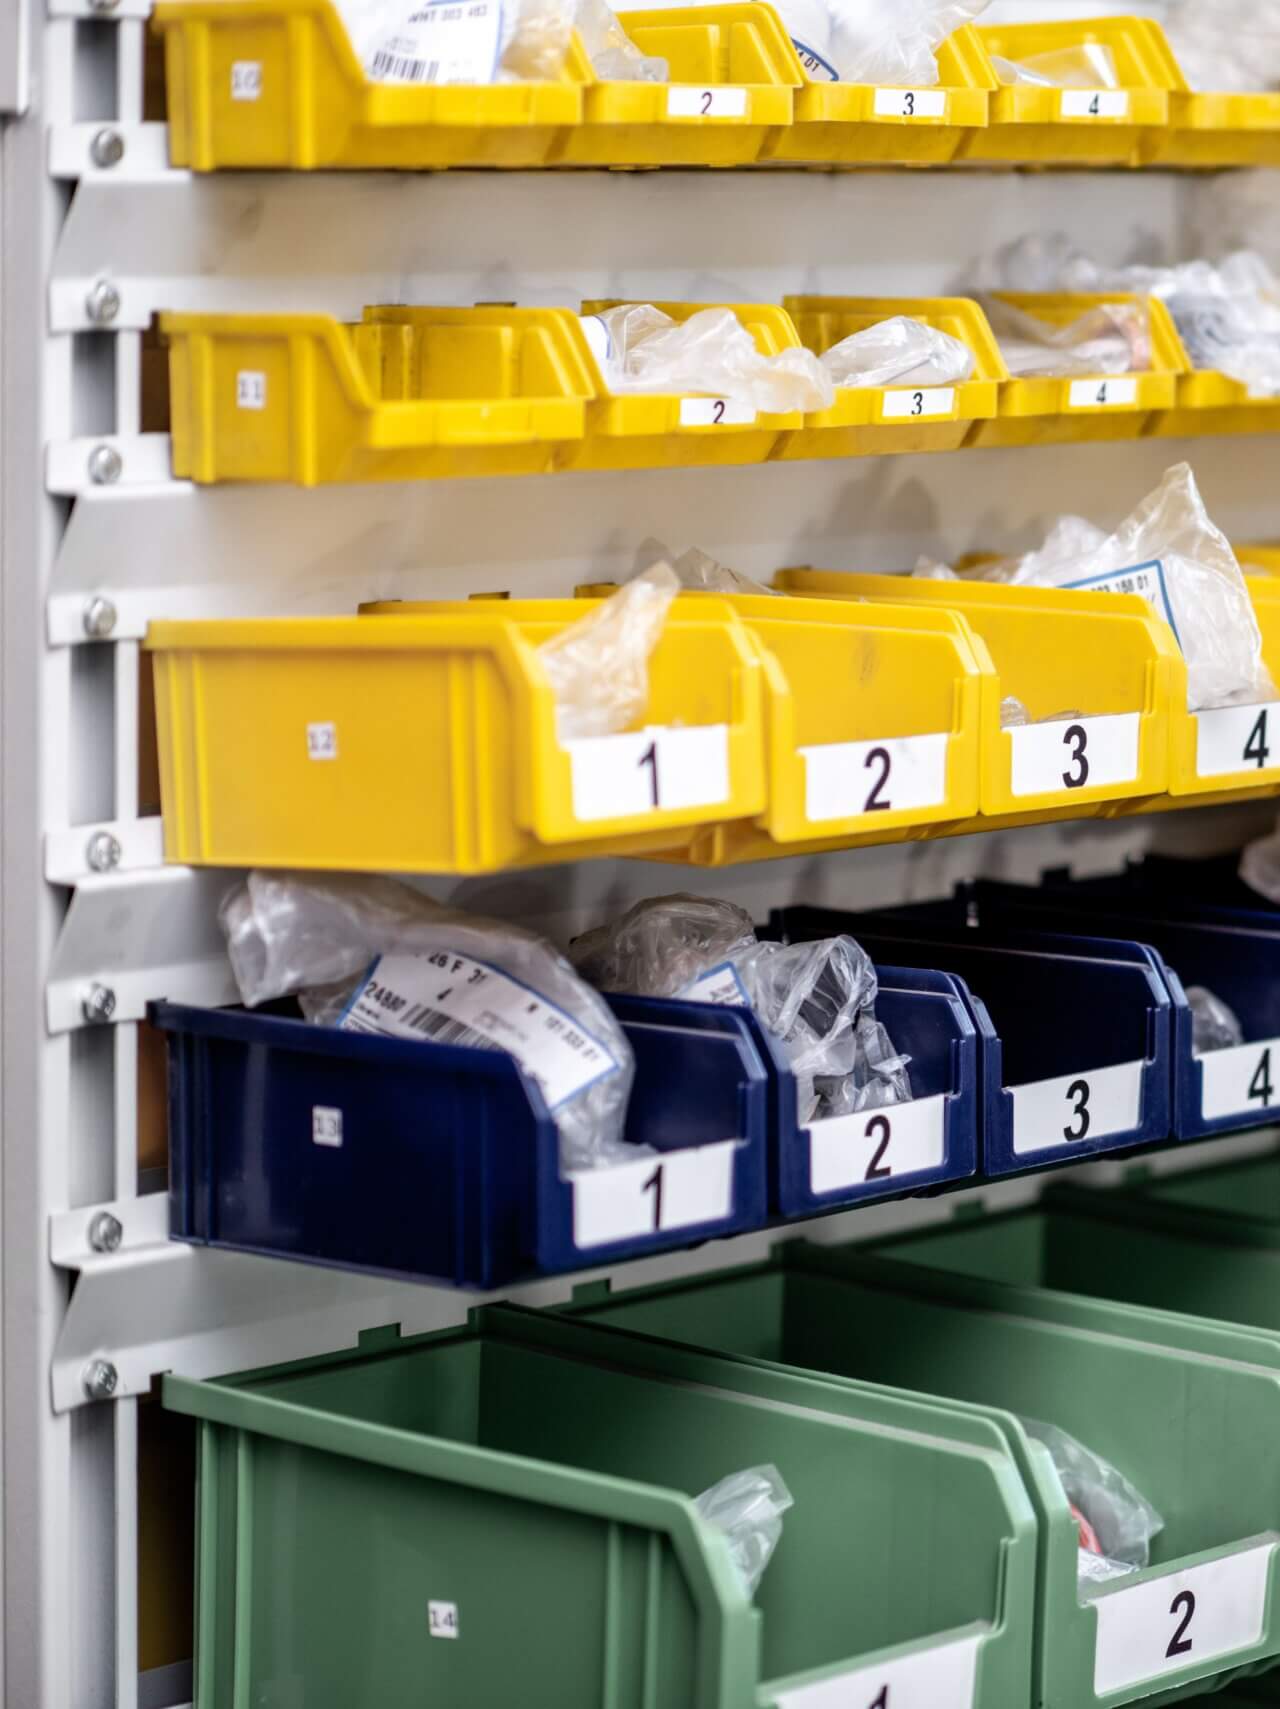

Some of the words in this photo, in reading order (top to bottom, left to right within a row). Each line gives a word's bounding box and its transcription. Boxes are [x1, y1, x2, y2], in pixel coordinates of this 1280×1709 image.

[701, 91, 713, 115] 2
[902, 92, 915, 116] 3
[1088, 94, 1100, 115] 4
[713, 400, 726, 425] 2
[911, 391, 923, 415] 3
[1095, 383, 1107, 405] 4
[1062, 724, 1089, 789] 3
[1242, 709, 1270, 769] 4
[639, 741, 660, 808] 1
[863, 747, 891, 813] 2
[1247, 1047, 1273, 1107] 4
[1063, 1079, 1090, 1142] 3
[864, 1114, 891, 1181] 2
[641, 1164, 663, 1230] 1
[431, 1609, 456, 1629] 14
[1165, 1590, 1196, 1659] 2
